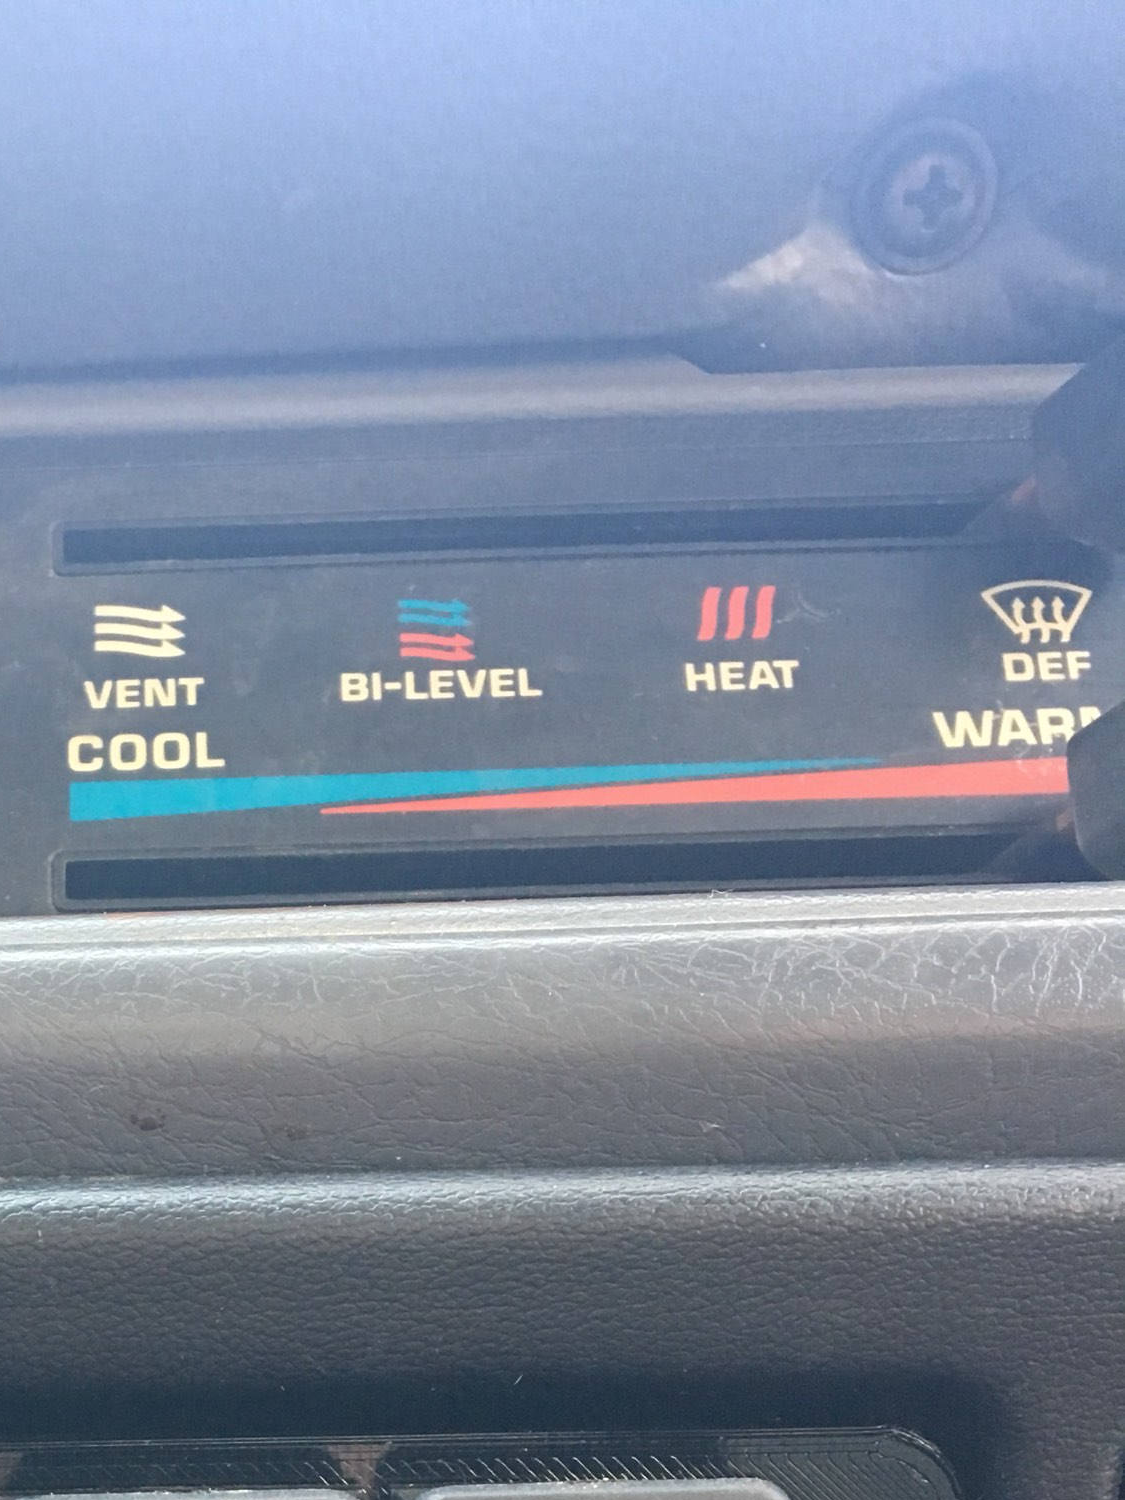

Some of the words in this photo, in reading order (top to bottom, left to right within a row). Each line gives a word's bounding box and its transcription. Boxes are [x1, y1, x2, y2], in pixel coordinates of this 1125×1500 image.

[684, 659, 800, 692] HEAT
[1002, 650, 1092, 682] DEF
[83, 677, 205, 710] VENT
[340, 667, 543, 702] BI-LEVEL
[67, 731, 226, 772] COOL
